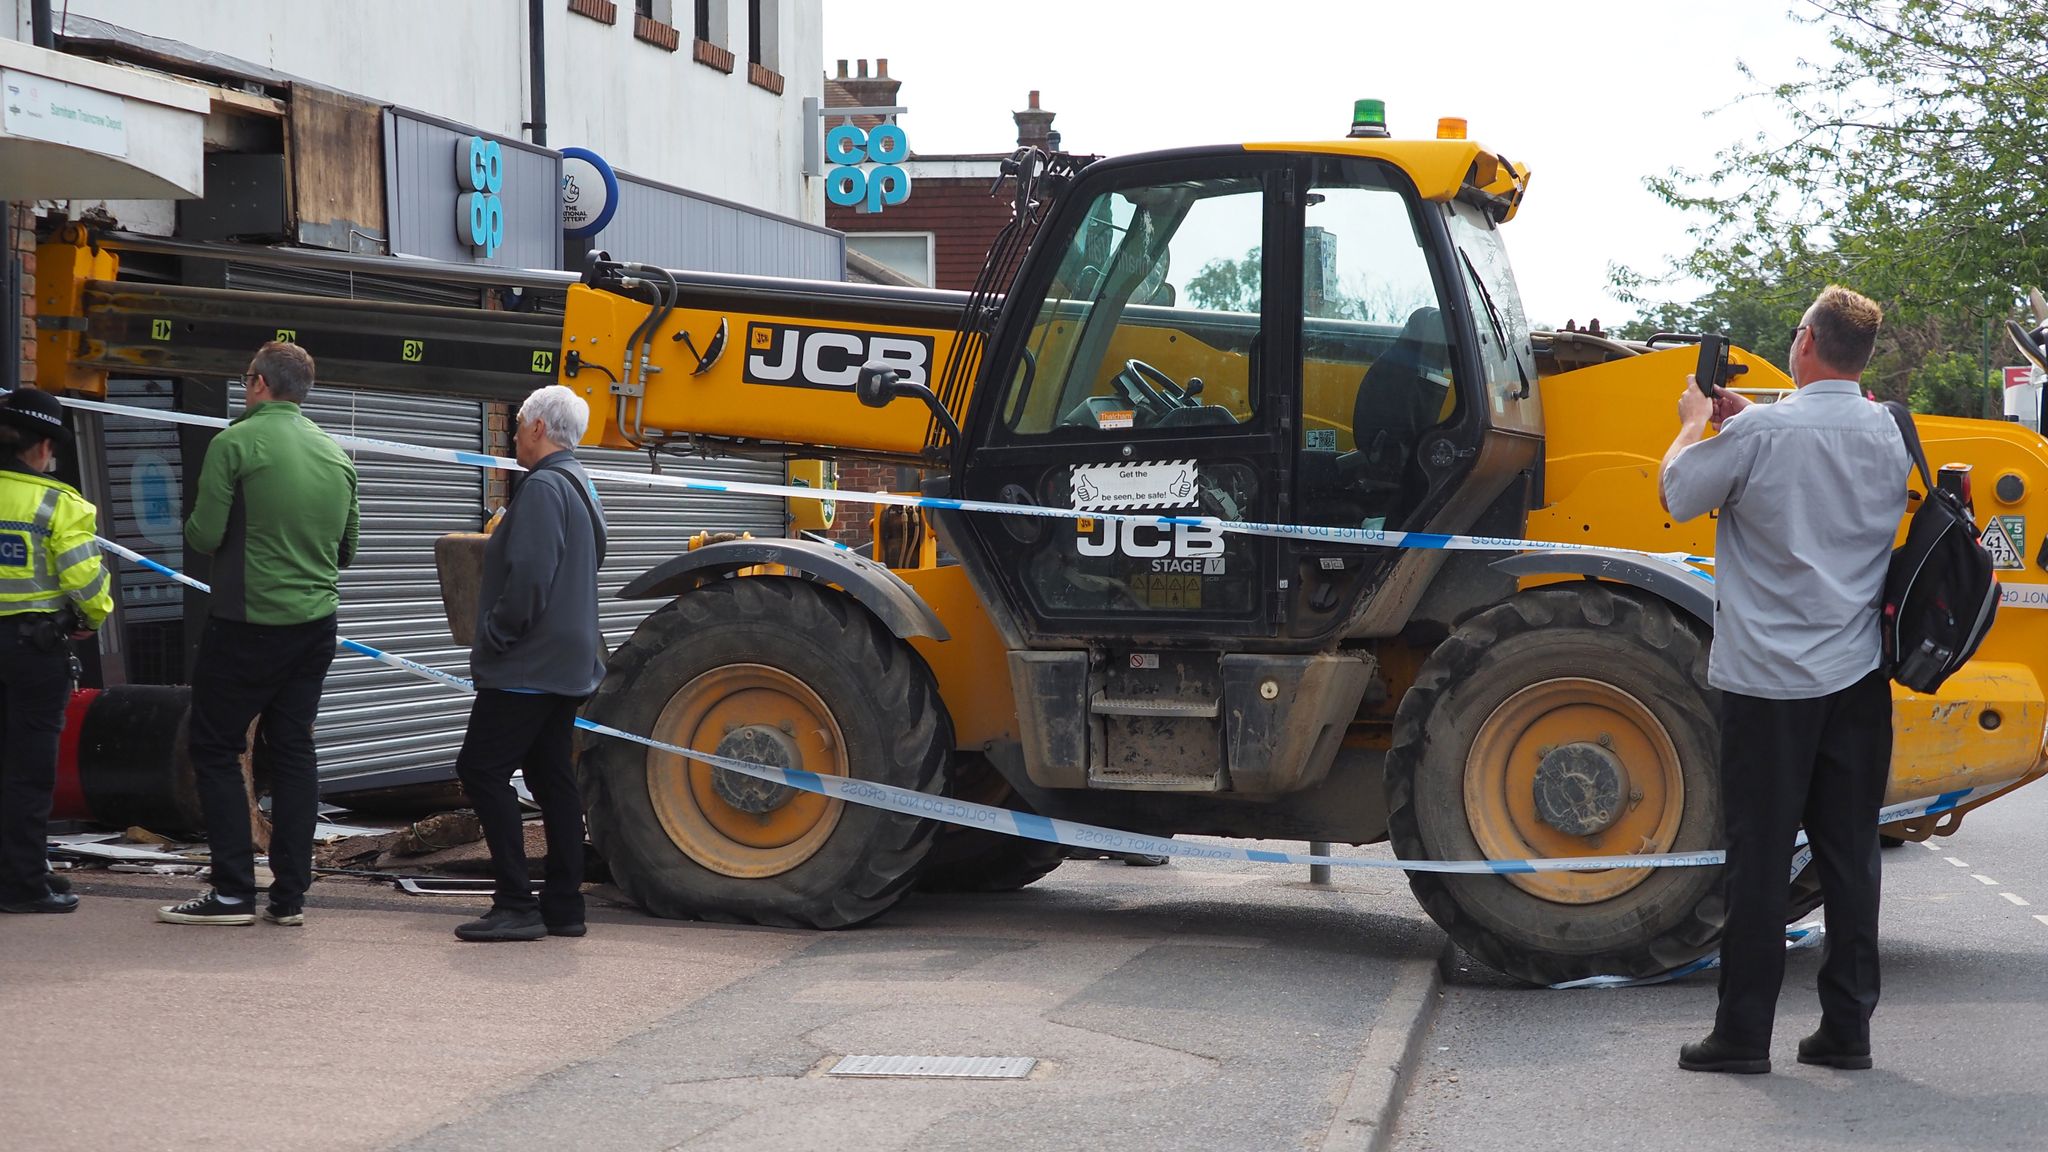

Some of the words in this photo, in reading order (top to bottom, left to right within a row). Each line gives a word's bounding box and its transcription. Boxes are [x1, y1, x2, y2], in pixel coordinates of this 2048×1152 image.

[154, 321, 162, 337] 1
[404, 343, 415, 359] 3
[749, 329, 928, 386] JCB
[533, 353, 544, 369] 4
[1119, 470, 1134, 478] Get
[1135, 470, 1148, 478] the
[1135, 492, 1146, 500] be
[1147, 491, 1167, 499] safe!
[2013, 523, 2023, 533] 5
[1076, 516, 1225, 558] JCB
[1986, 536, 2002, 549] 41
[1151, 559, 1202, 572] STAGE
[1210, 559, 1221, 572] V
